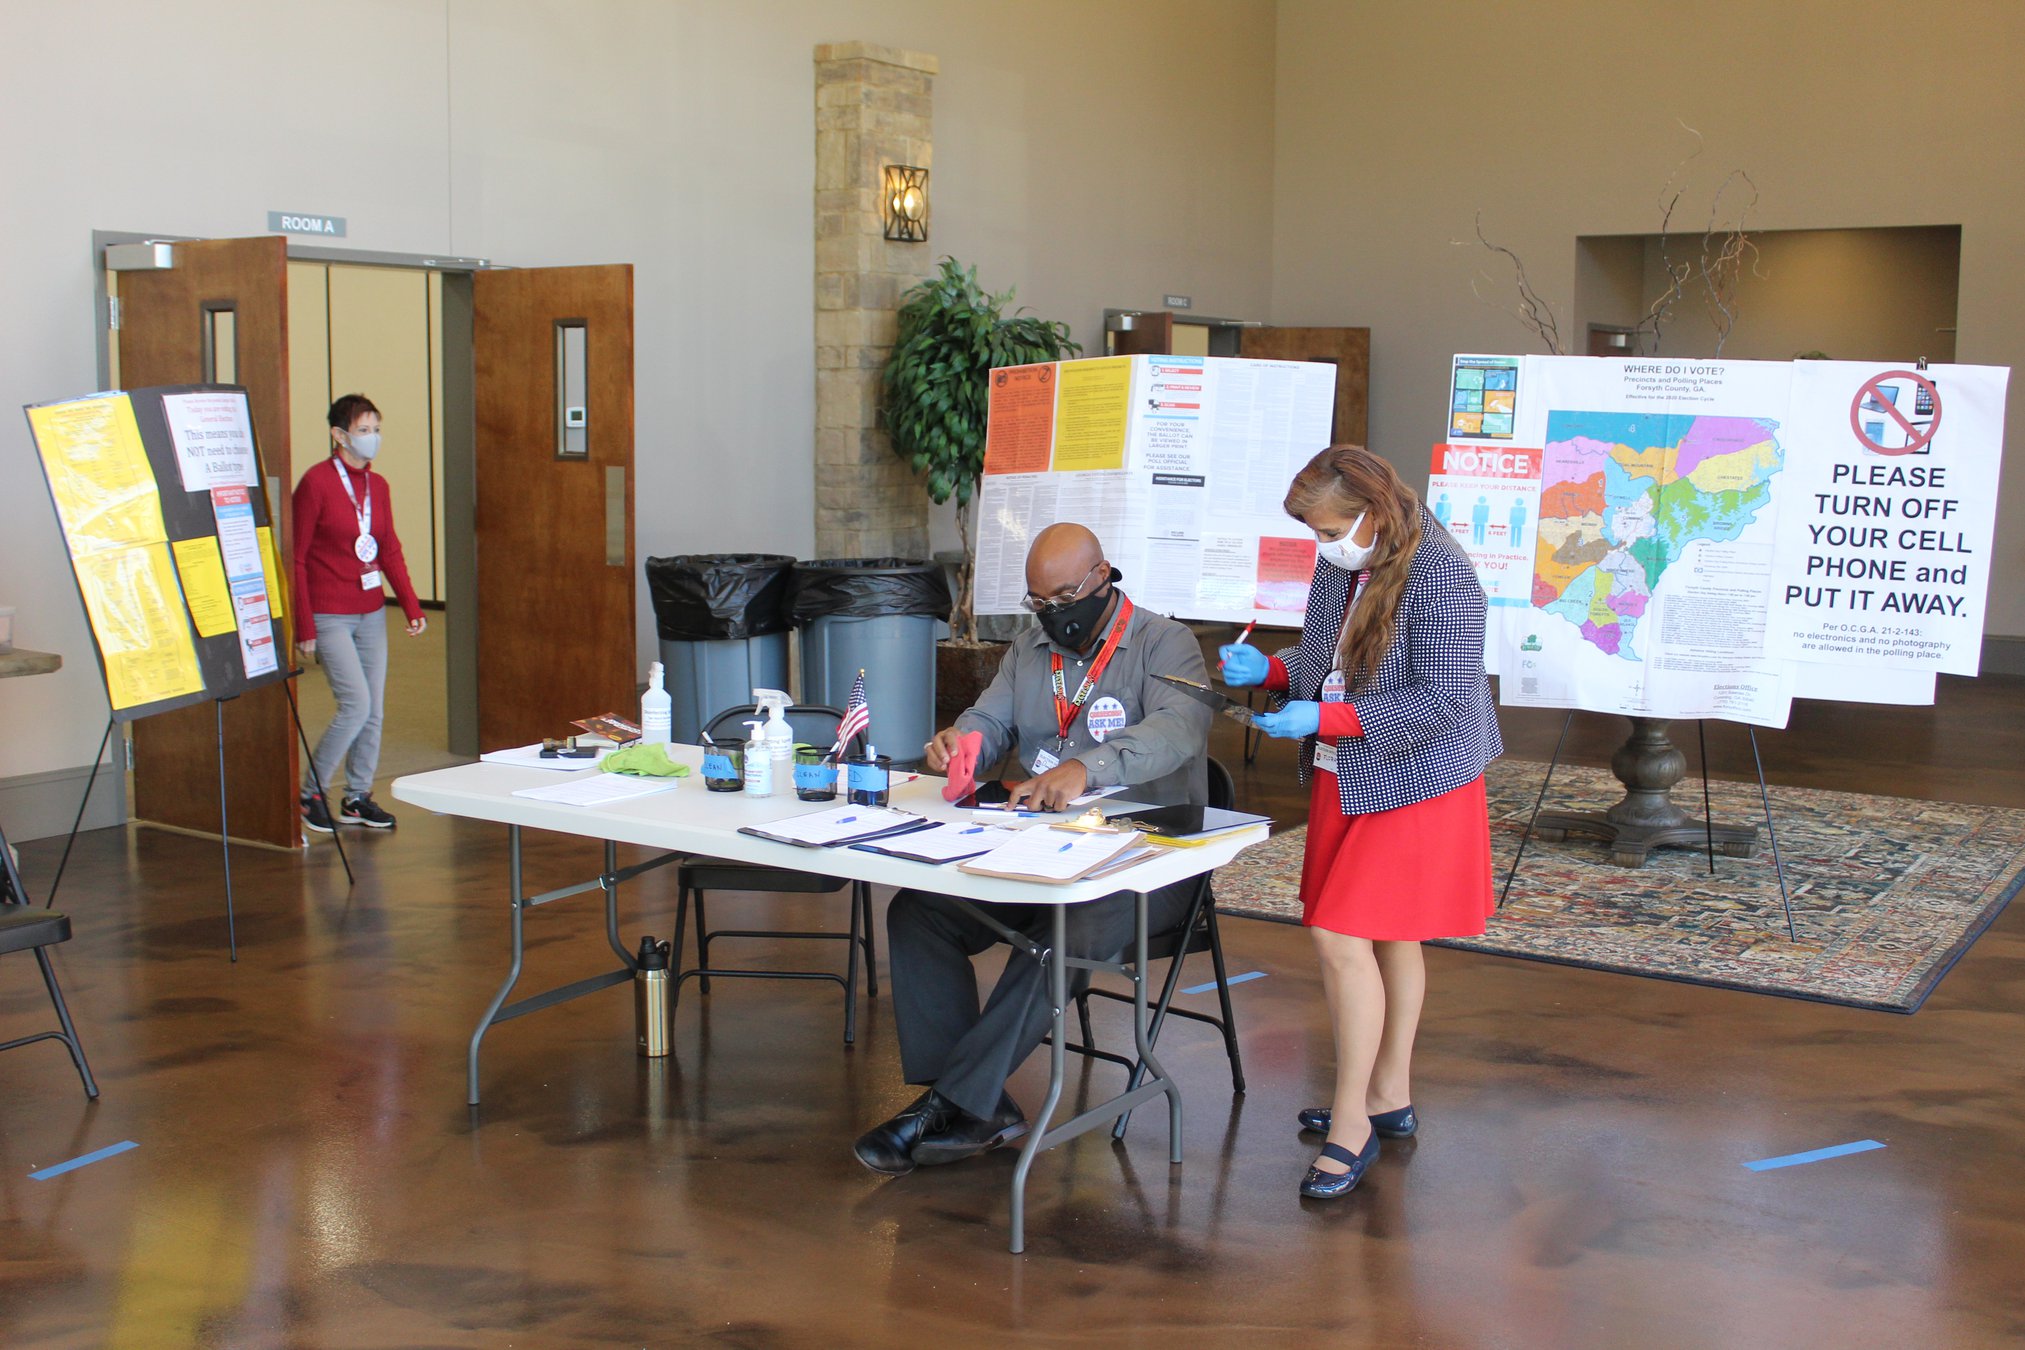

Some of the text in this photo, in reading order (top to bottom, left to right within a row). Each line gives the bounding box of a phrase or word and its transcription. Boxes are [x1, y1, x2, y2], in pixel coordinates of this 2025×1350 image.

[282, 216, 334, 233] ROOM A
[1624, 364, 1725, 376] WHERE DO I VOTE?
[1673, 377, 1697, 385] Polling
[184, 430, 204, 440] This
[187, 446, 205, 457] NOT
[1443, 451, 1529, 474] NOTICE
[1832, 464, 1946, 488] PLEASE
[1815, 494, 1959, 519] TURN OFF
[1808, 524, 1972, 553] YOUR CELL
[1807, 556, 1968, 585] PHONE and
[1785, 585, 1967, 618] PUT IT AWAY.
[1823, 623, 1923, 637] Per O.C.G.A. 21-2-143:
[1807, 632, 1856, 642] electronics
[1859, 635, 1876, 644] and
[1892, 637, 1951, 650] photography
[1818, 642, 1853, 653] allowed
[1855, 645, 1864, 653] in
[1866, 646, 1880, 655] the
[1883, 647, 1914, 659] polling
[1916, 648, 1944, 660] place.
[1324, 693, 1341, 702] ASK
[1089, 718, 1125, 728] ASK ME!
